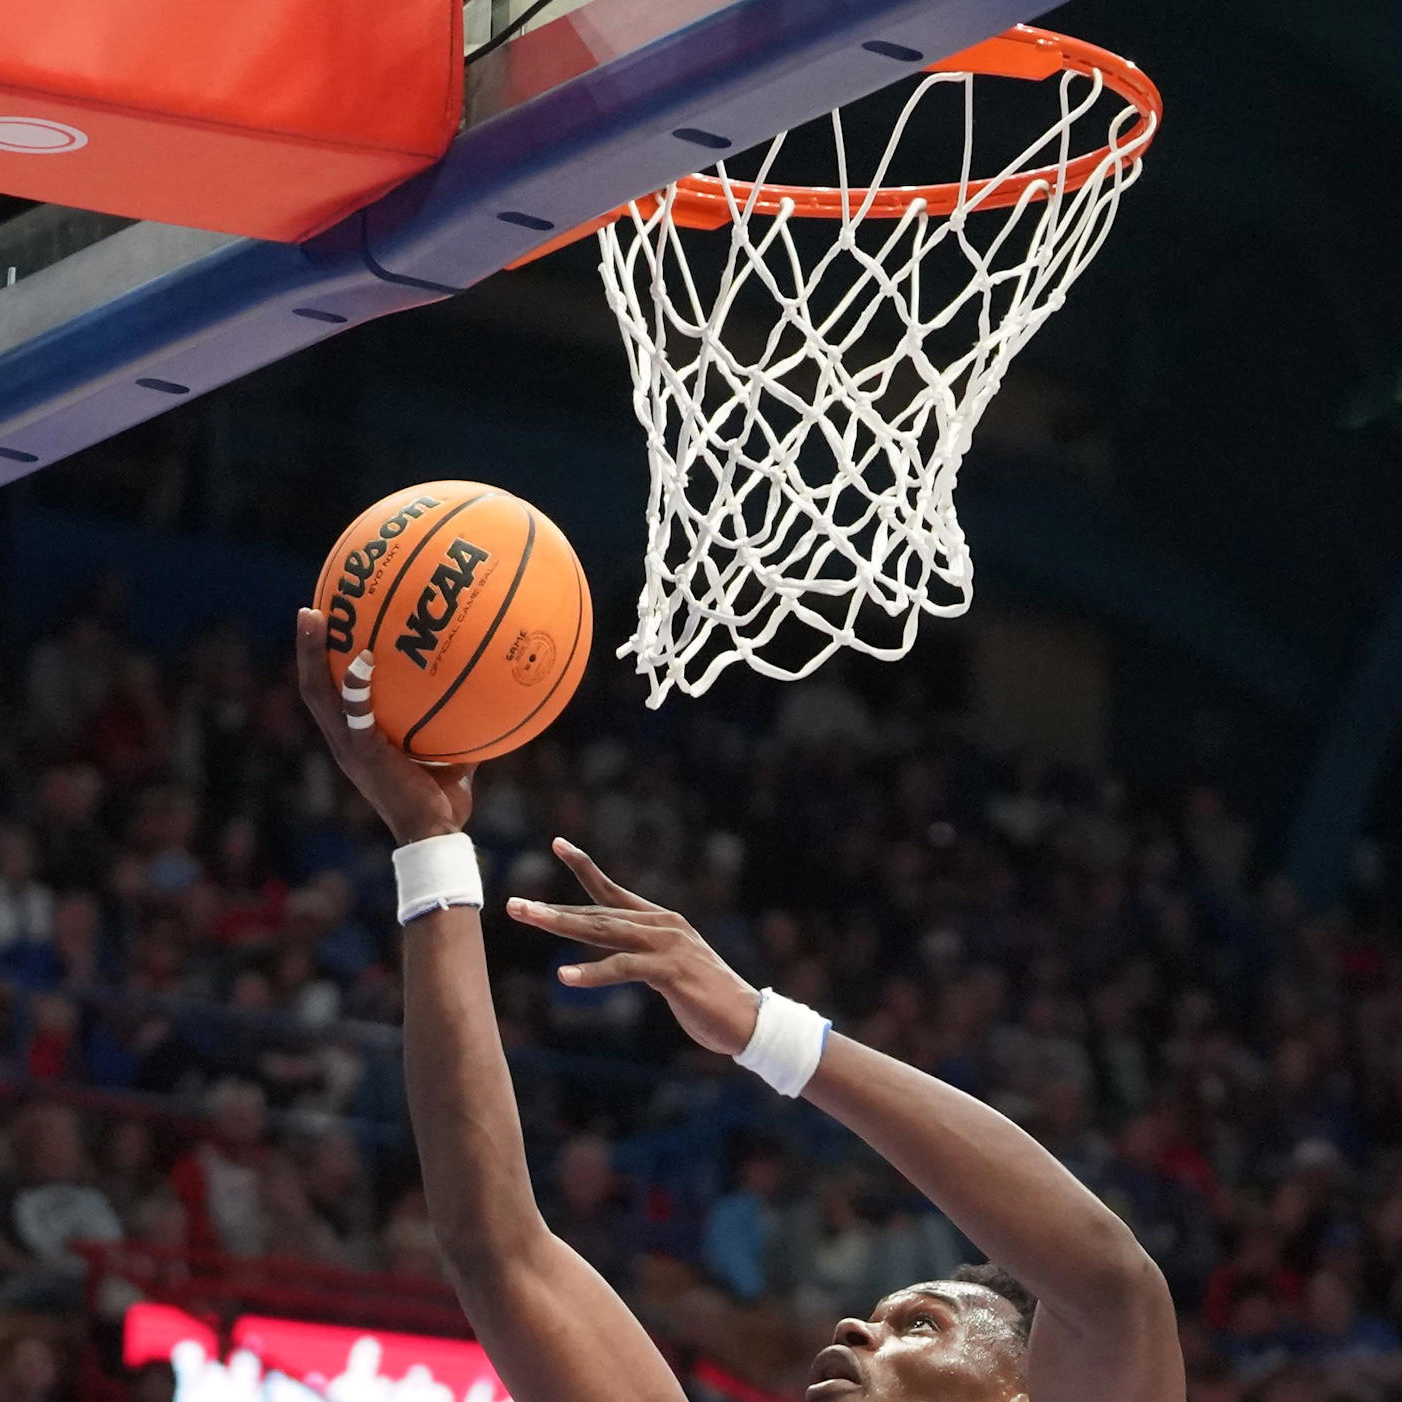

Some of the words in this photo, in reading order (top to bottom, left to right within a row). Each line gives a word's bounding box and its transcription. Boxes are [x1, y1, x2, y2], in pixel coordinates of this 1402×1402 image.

[327, 496, 441, 653] Wilson
[369, 570, 383, 595] EVO
[395, 537, 491, 670] NCAA
